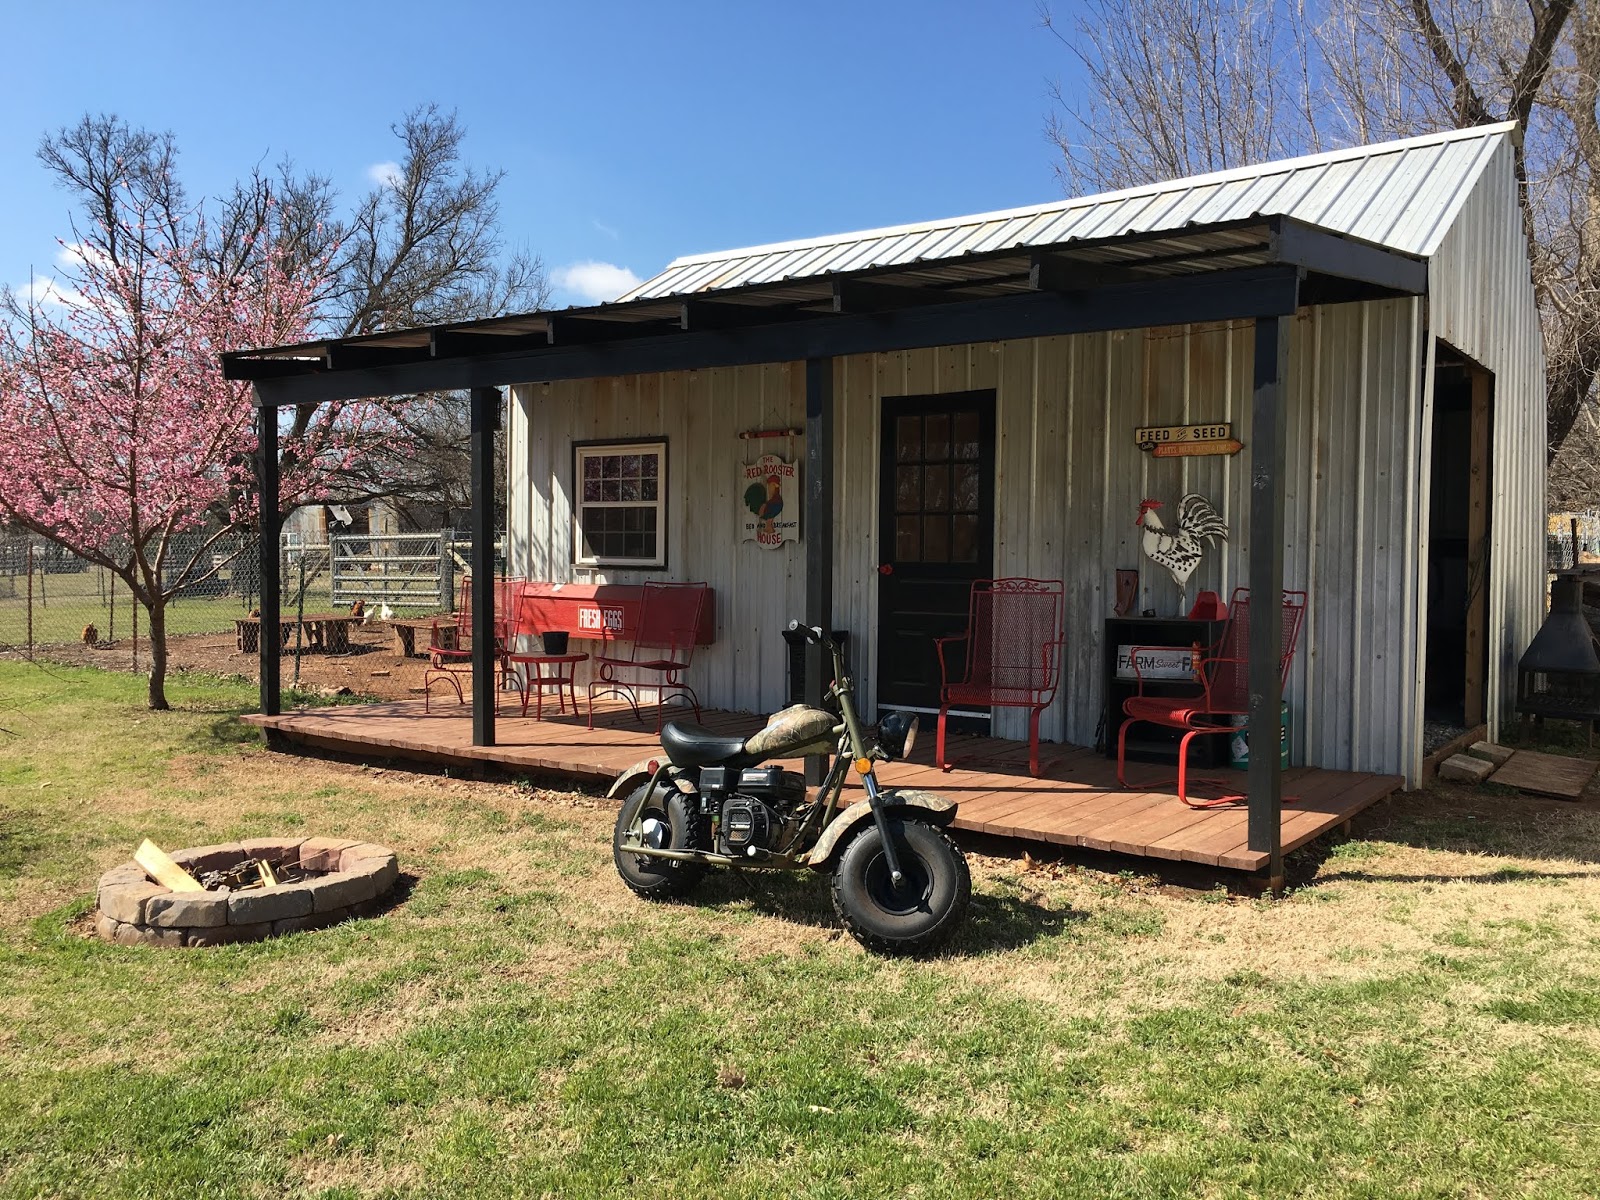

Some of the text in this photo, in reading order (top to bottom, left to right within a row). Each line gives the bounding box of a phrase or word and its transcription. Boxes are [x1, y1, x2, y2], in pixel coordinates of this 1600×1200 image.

[1140, 430, 1170, 441] FEED
[1193, 427, 1226, 439] SEED
[746, 464, 795, 479] RED ROOSTER
[757, 532, 782, 545] HOUSE
[579, 608, 623, 631] FRESH EGGS
[1118, 654, 1155, 670] FARM
[1155, 658, 1180, 669] Sweet
